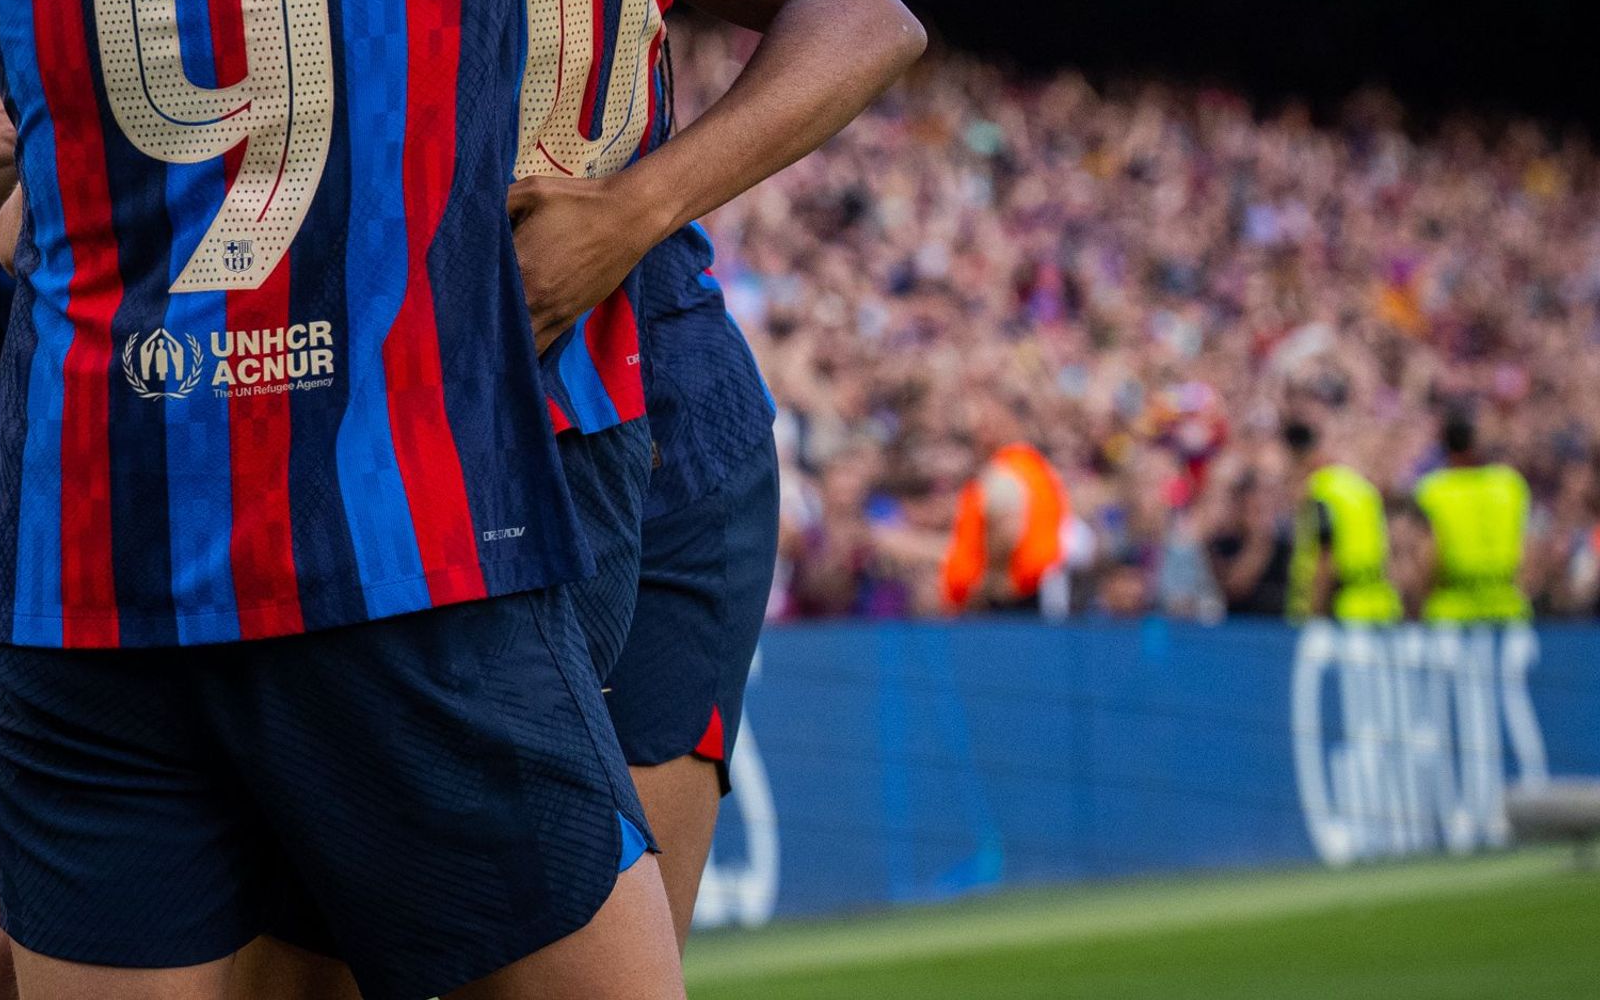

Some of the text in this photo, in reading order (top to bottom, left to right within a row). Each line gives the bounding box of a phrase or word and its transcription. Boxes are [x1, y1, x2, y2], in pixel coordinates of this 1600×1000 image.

[211, 320, 333, 357] UNHCR
[211, 349, 334, 385] ACNUR
[213, 377, 334, 398] The UN Refugee Agency
